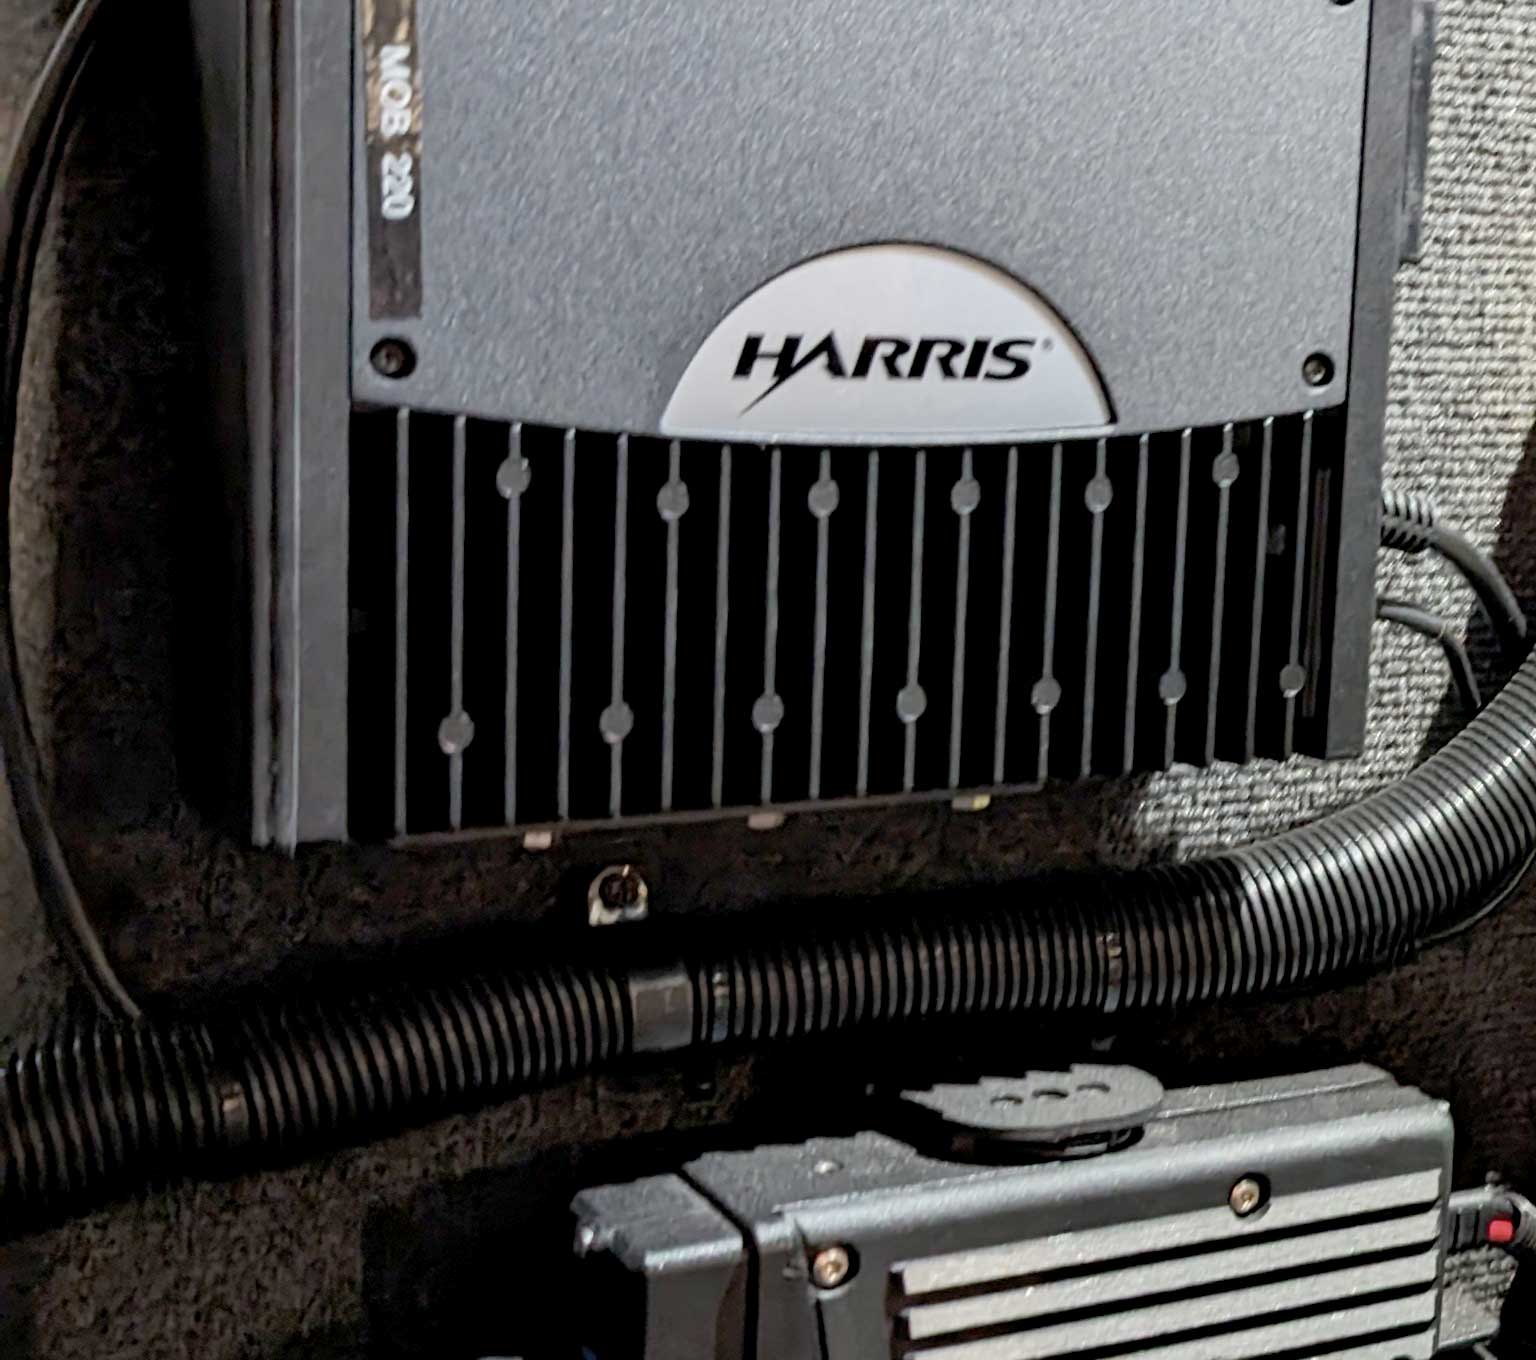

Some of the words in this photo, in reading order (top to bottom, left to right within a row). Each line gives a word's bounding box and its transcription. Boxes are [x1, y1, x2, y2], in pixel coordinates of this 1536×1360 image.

[380, 44, 413, 139] MOB
[381, 152, 415, 221] 220
[732, 331, 1039, 418] HARRIS
